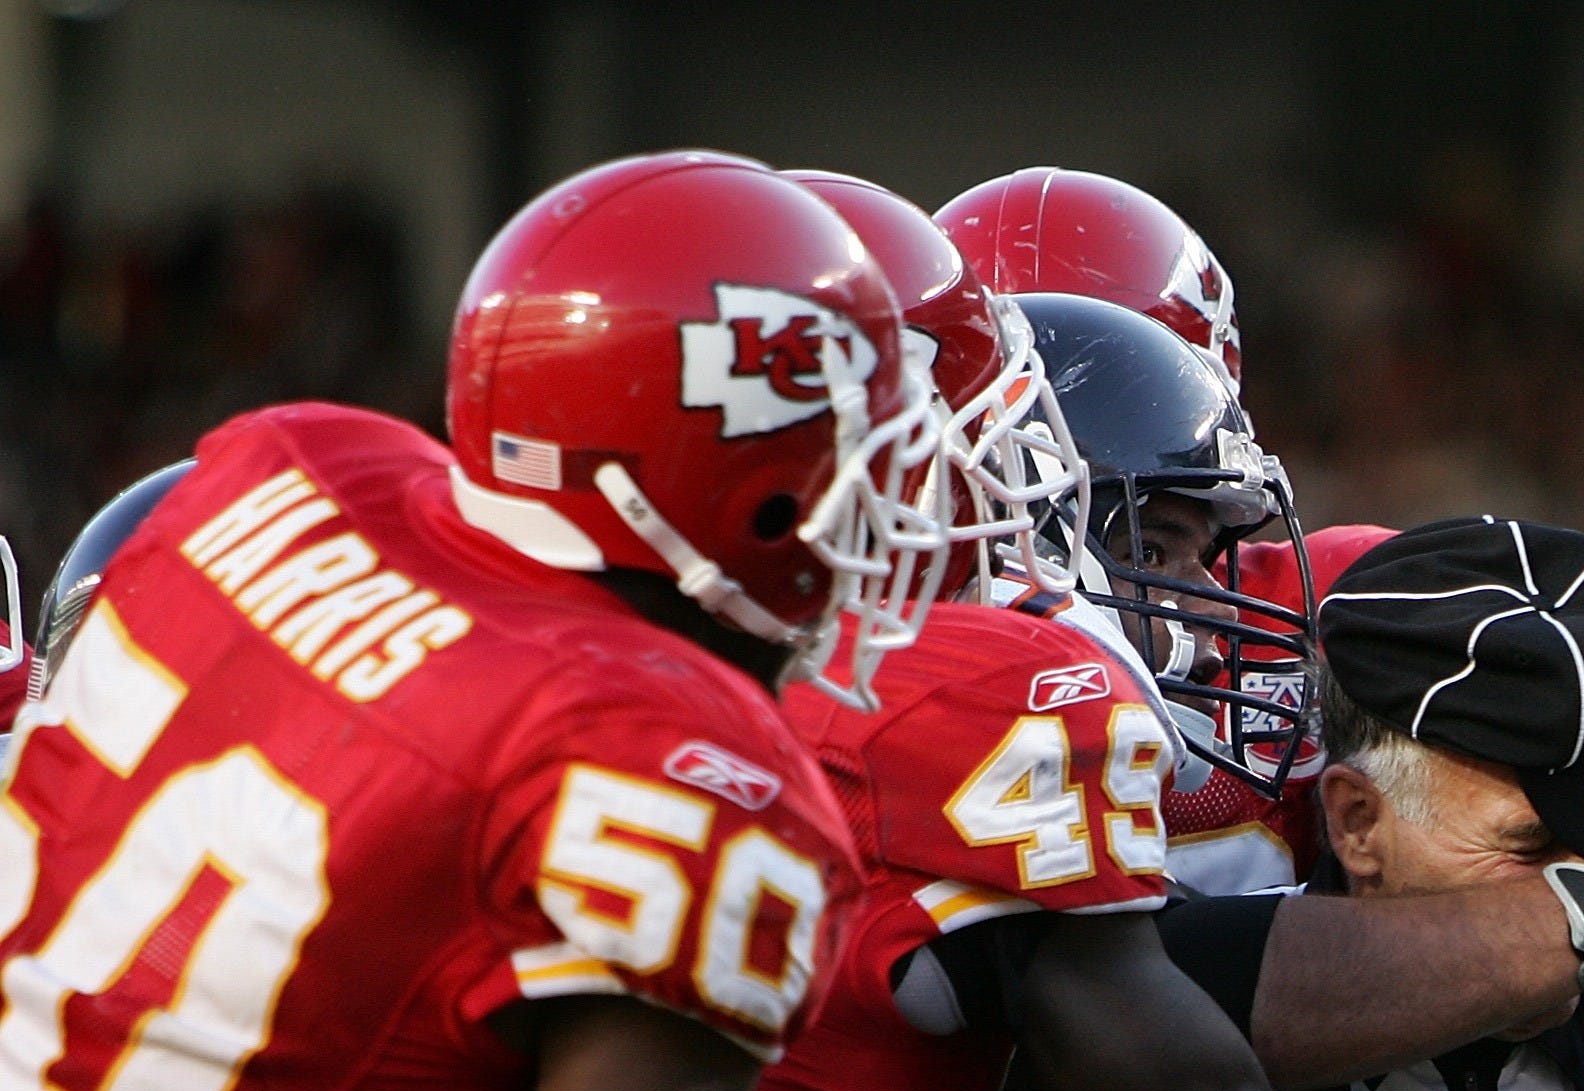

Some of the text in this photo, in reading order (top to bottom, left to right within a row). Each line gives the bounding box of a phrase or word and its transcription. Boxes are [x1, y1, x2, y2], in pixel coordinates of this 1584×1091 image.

[178, 467, 475, 703] HARRIS
[535, 763, 828, 1035] 50
[942, 702, 1173, 890] 49
